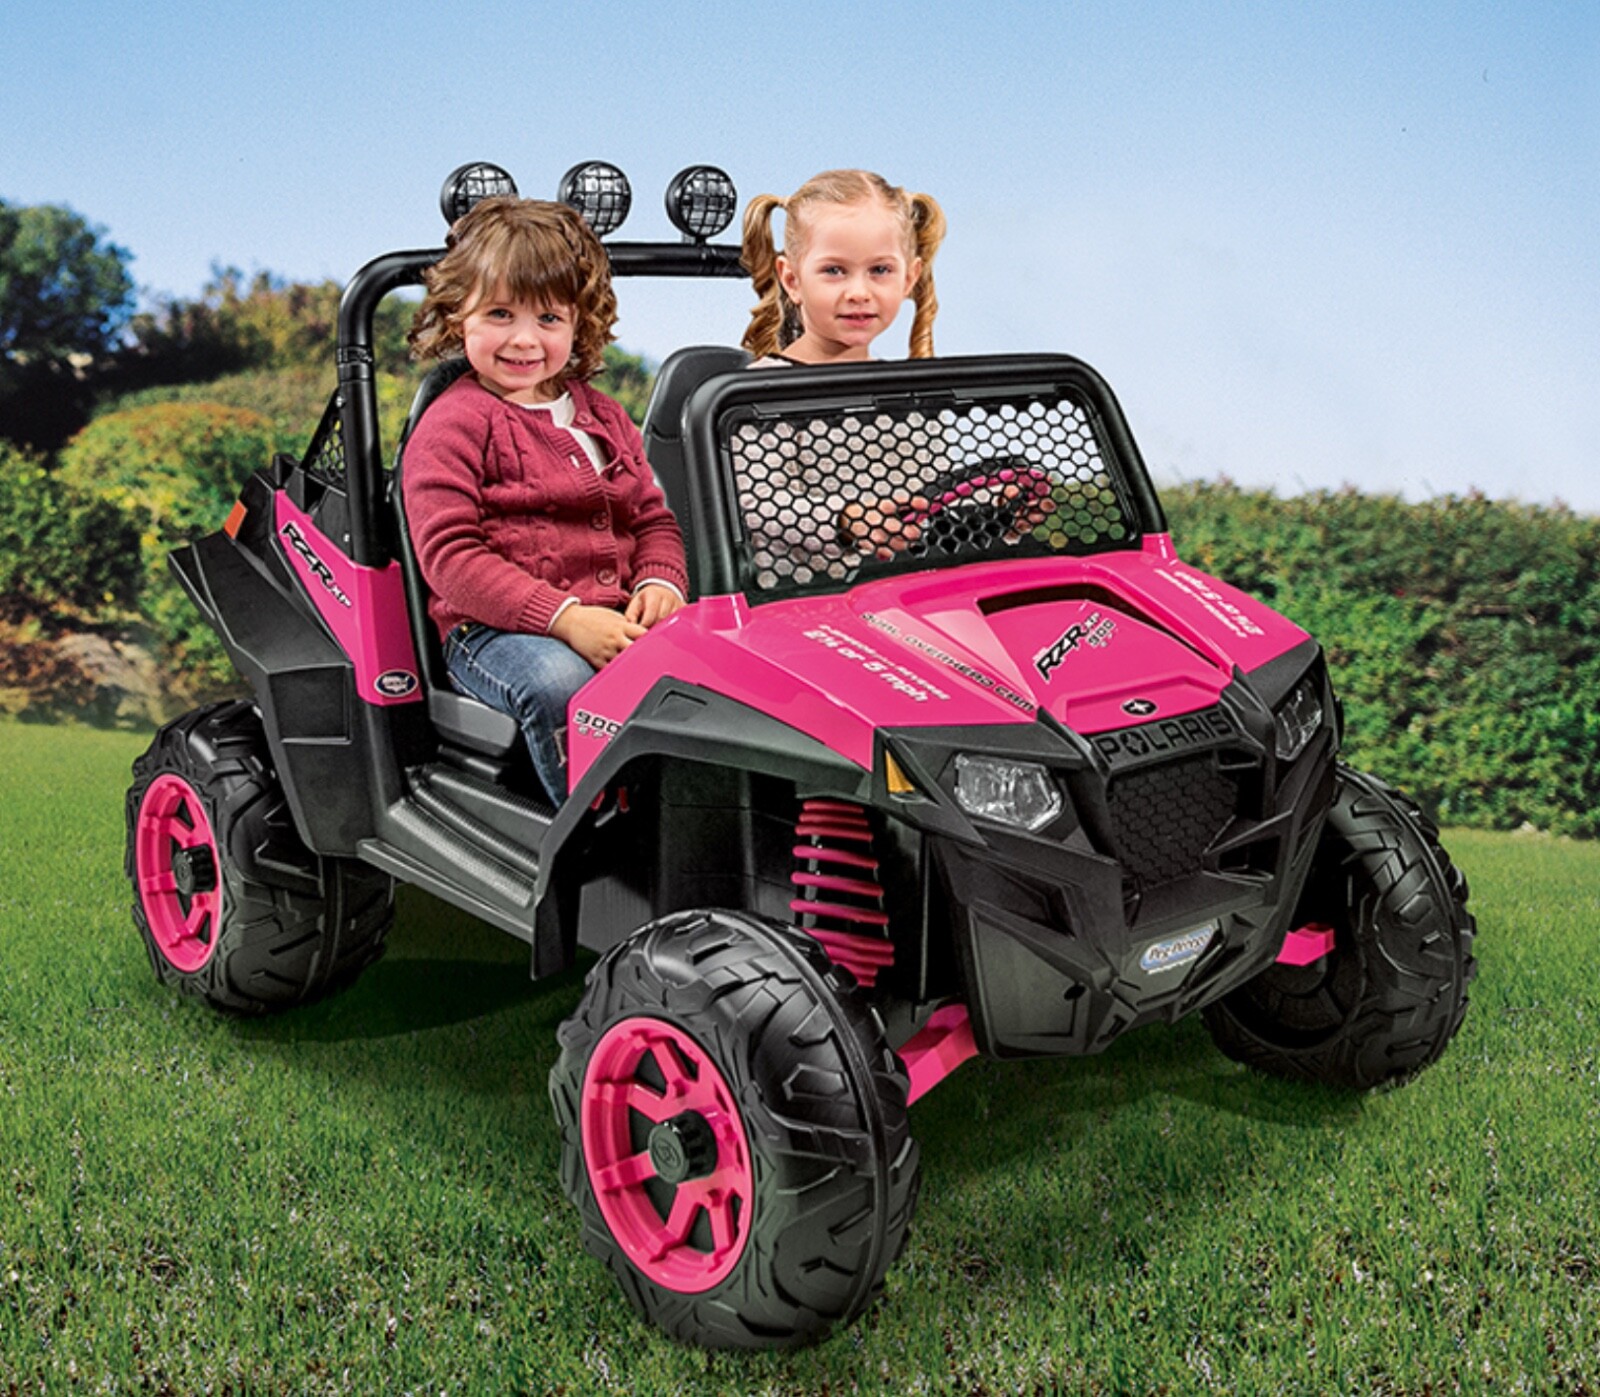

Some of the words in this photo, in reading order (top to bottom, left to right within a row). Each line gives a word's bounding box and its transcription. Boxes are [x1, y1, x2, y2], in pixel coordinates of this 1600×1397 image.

[280, 520, 335, 591] RZR
[1033, 623, 1090, 685] RZR
[1087, 618, 1116, 648] 900
[879, 672, 929, 703] mph
[903, 634, 995, 689] OVERHEAD
[573, 708, 623, 737] 900
[1094, 710, 1234, 765] POLARIS
